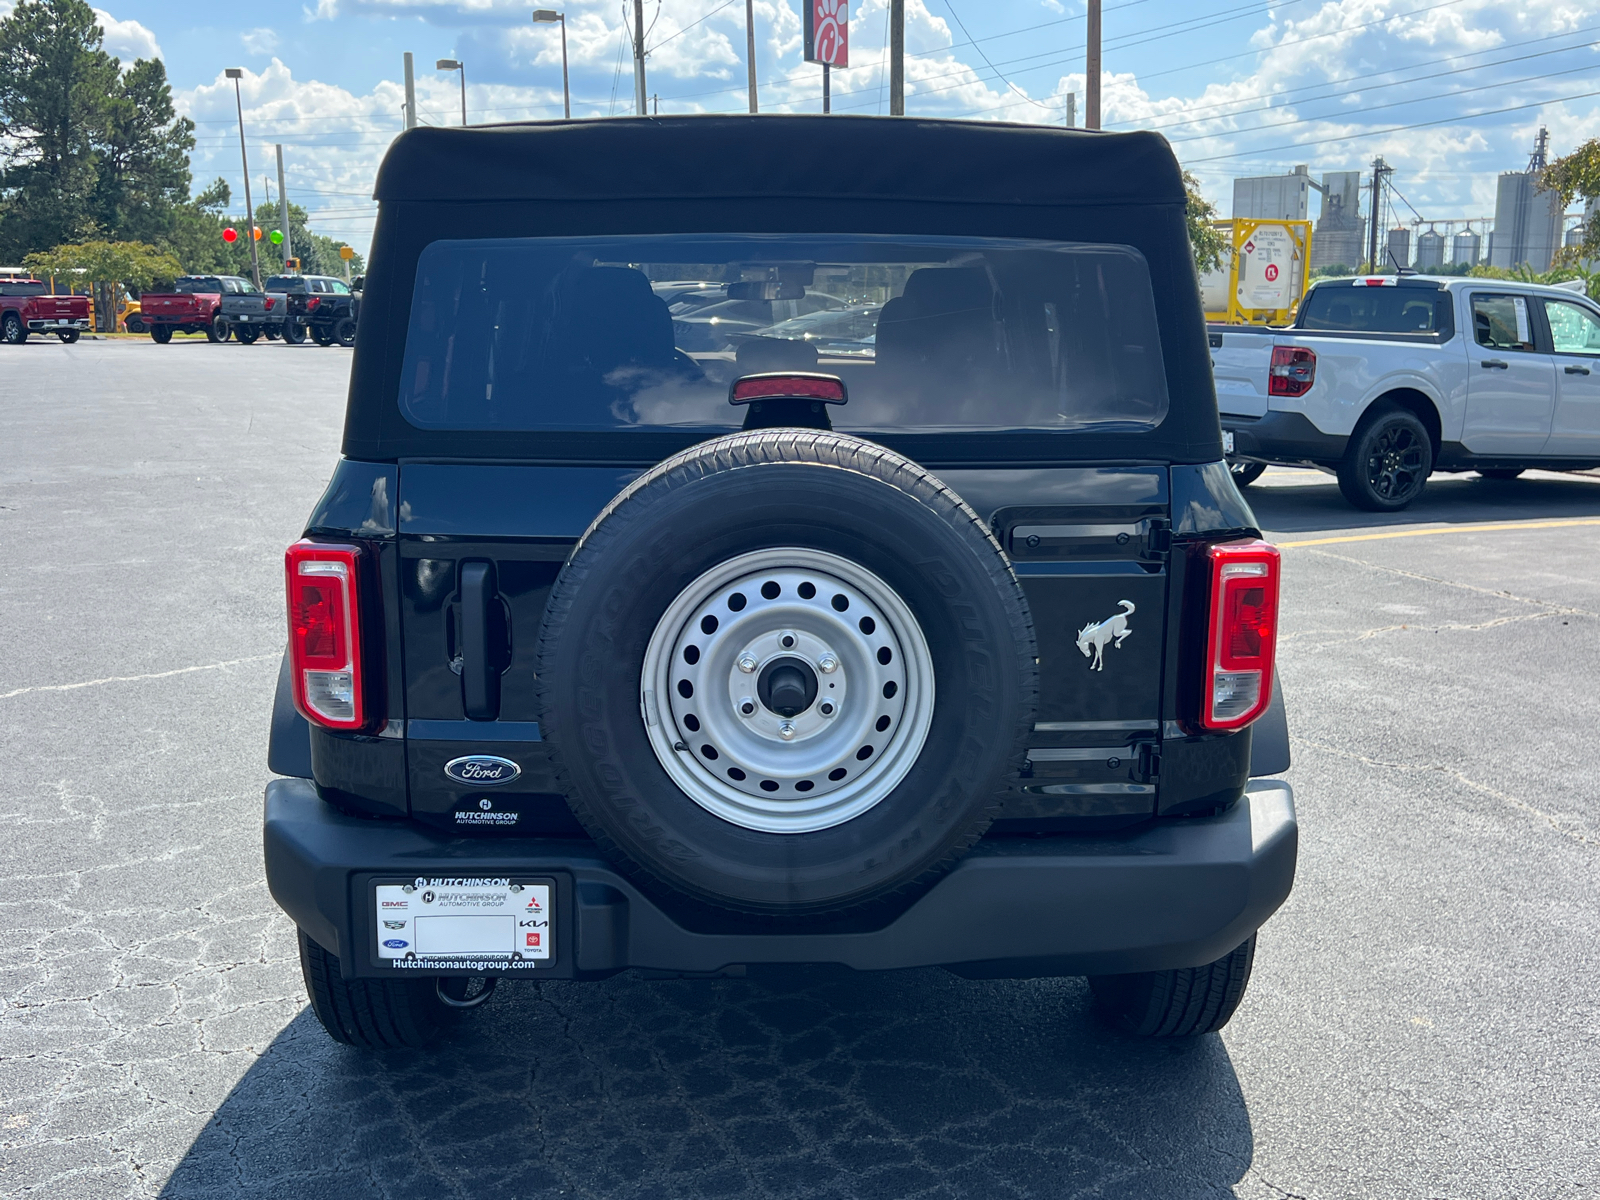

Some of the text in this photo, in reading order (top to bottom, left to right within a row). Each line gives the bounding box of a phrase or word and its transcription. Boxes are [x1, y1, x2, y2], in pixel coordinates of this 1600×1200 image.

[461, 761, 502, 778] Ford
[454, 811, 518, 820] HUTCHINSON
[429, 878, 510, 887] HUTCHINSON
[438, 893, 508, 901] HUTCHINSON
[519, 920, 548, 928] KIA
[387, 940, 404, 948] Ford
[393, 958, 535, 970] Hutchinsonautogroup.com
